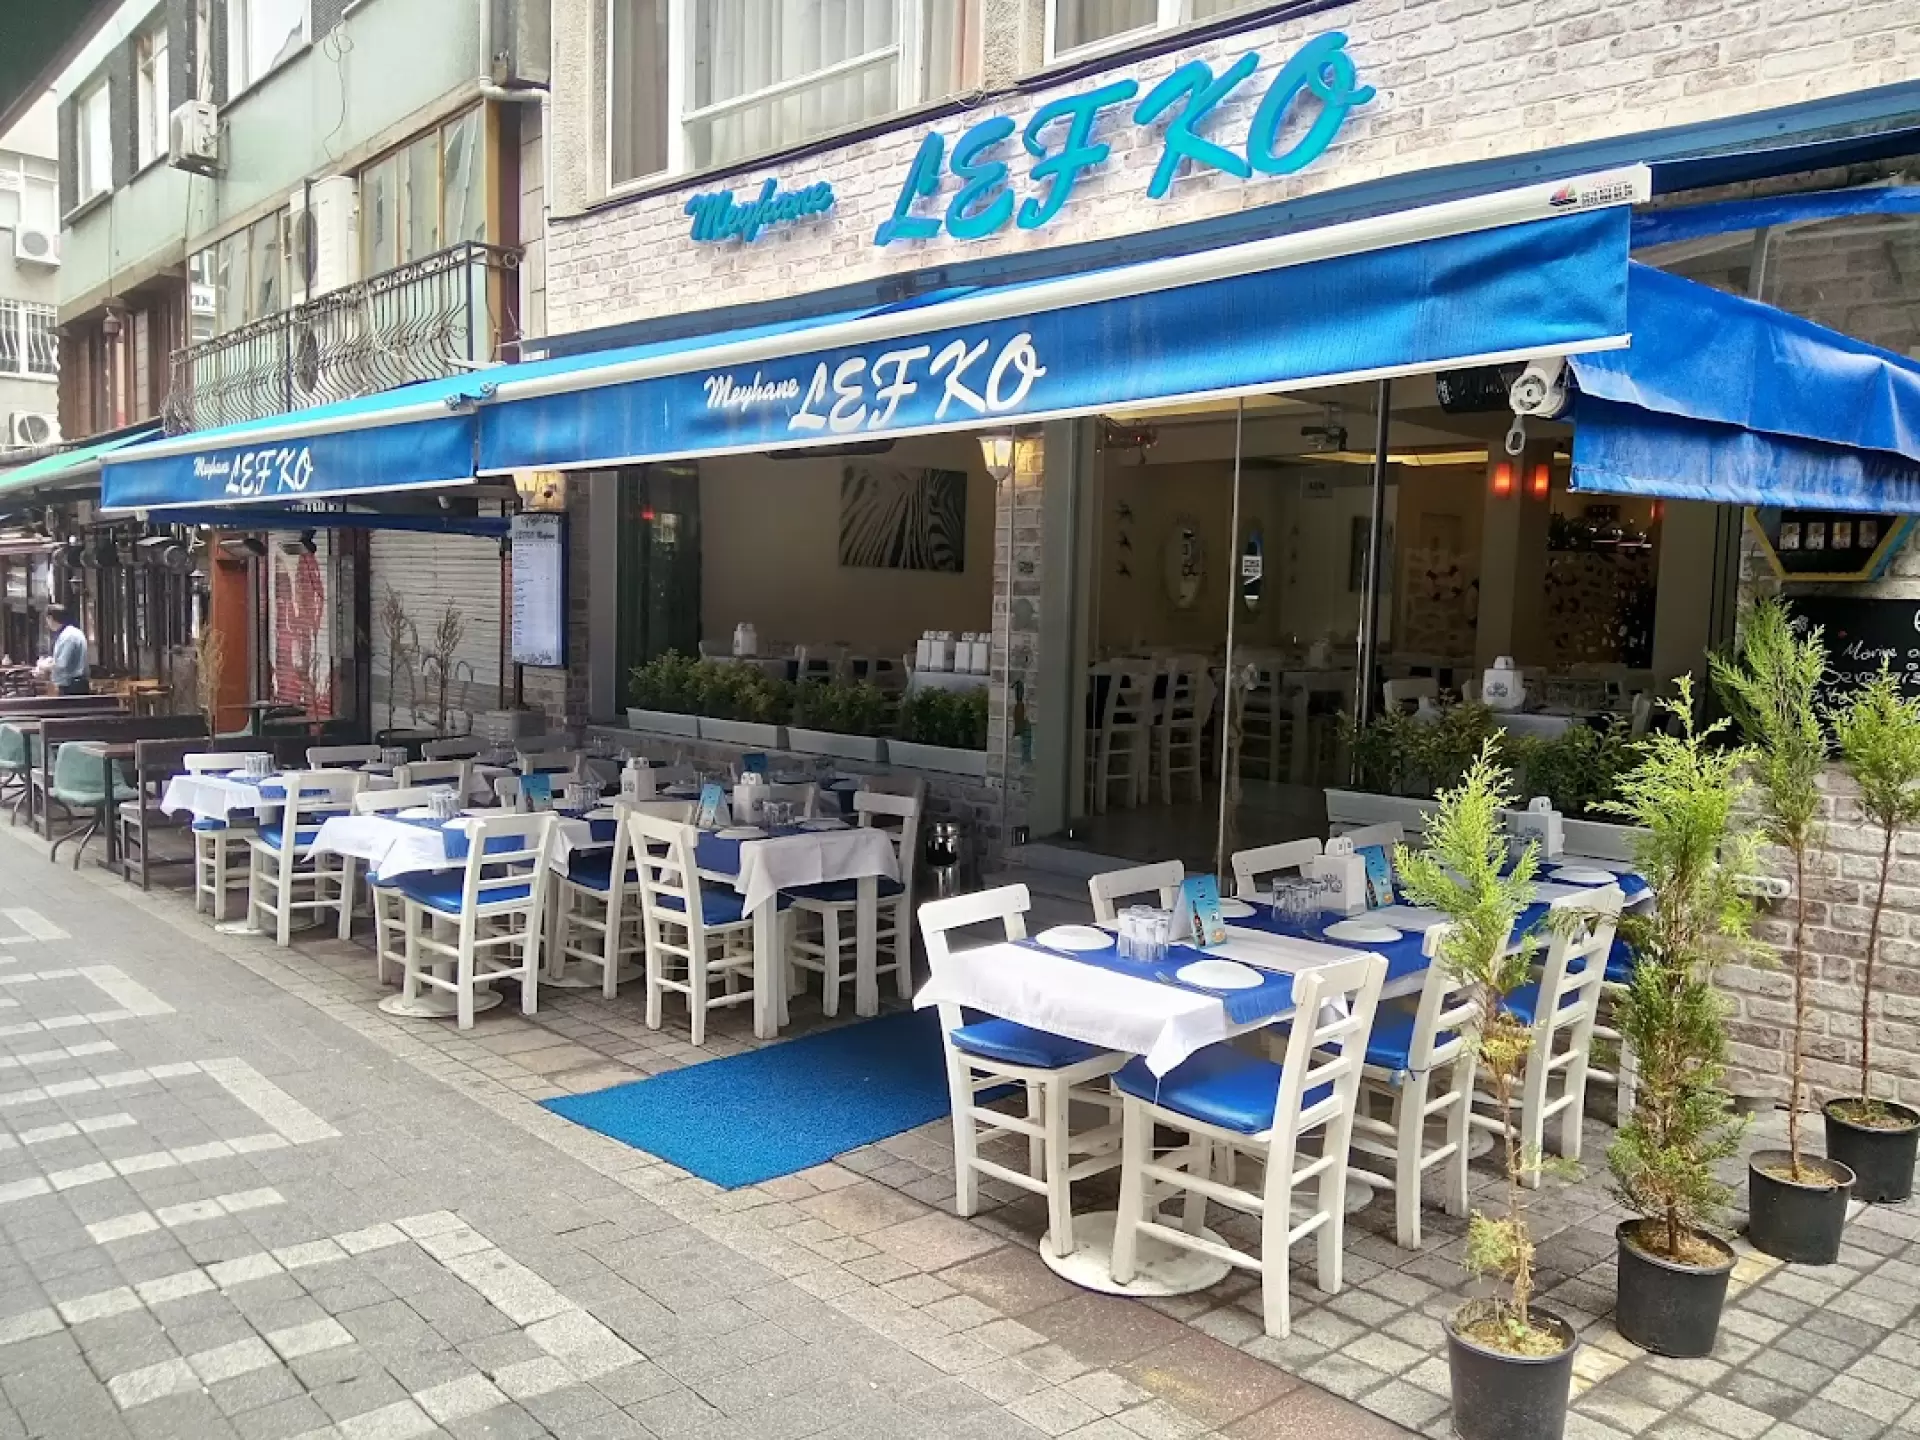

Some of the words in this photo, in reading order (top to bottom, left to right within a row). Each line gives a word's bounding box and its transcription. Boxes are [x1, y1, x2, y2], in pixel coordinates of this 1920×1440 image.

[684, 178, 835, 242] Meyhane
[873, 32, 1374, 246] LEFKO
[704, 371, 799, 412] Meyhane
[788, 332, 1046, 432] LEFKO
[225, 446, 313, 496] LEFKO
